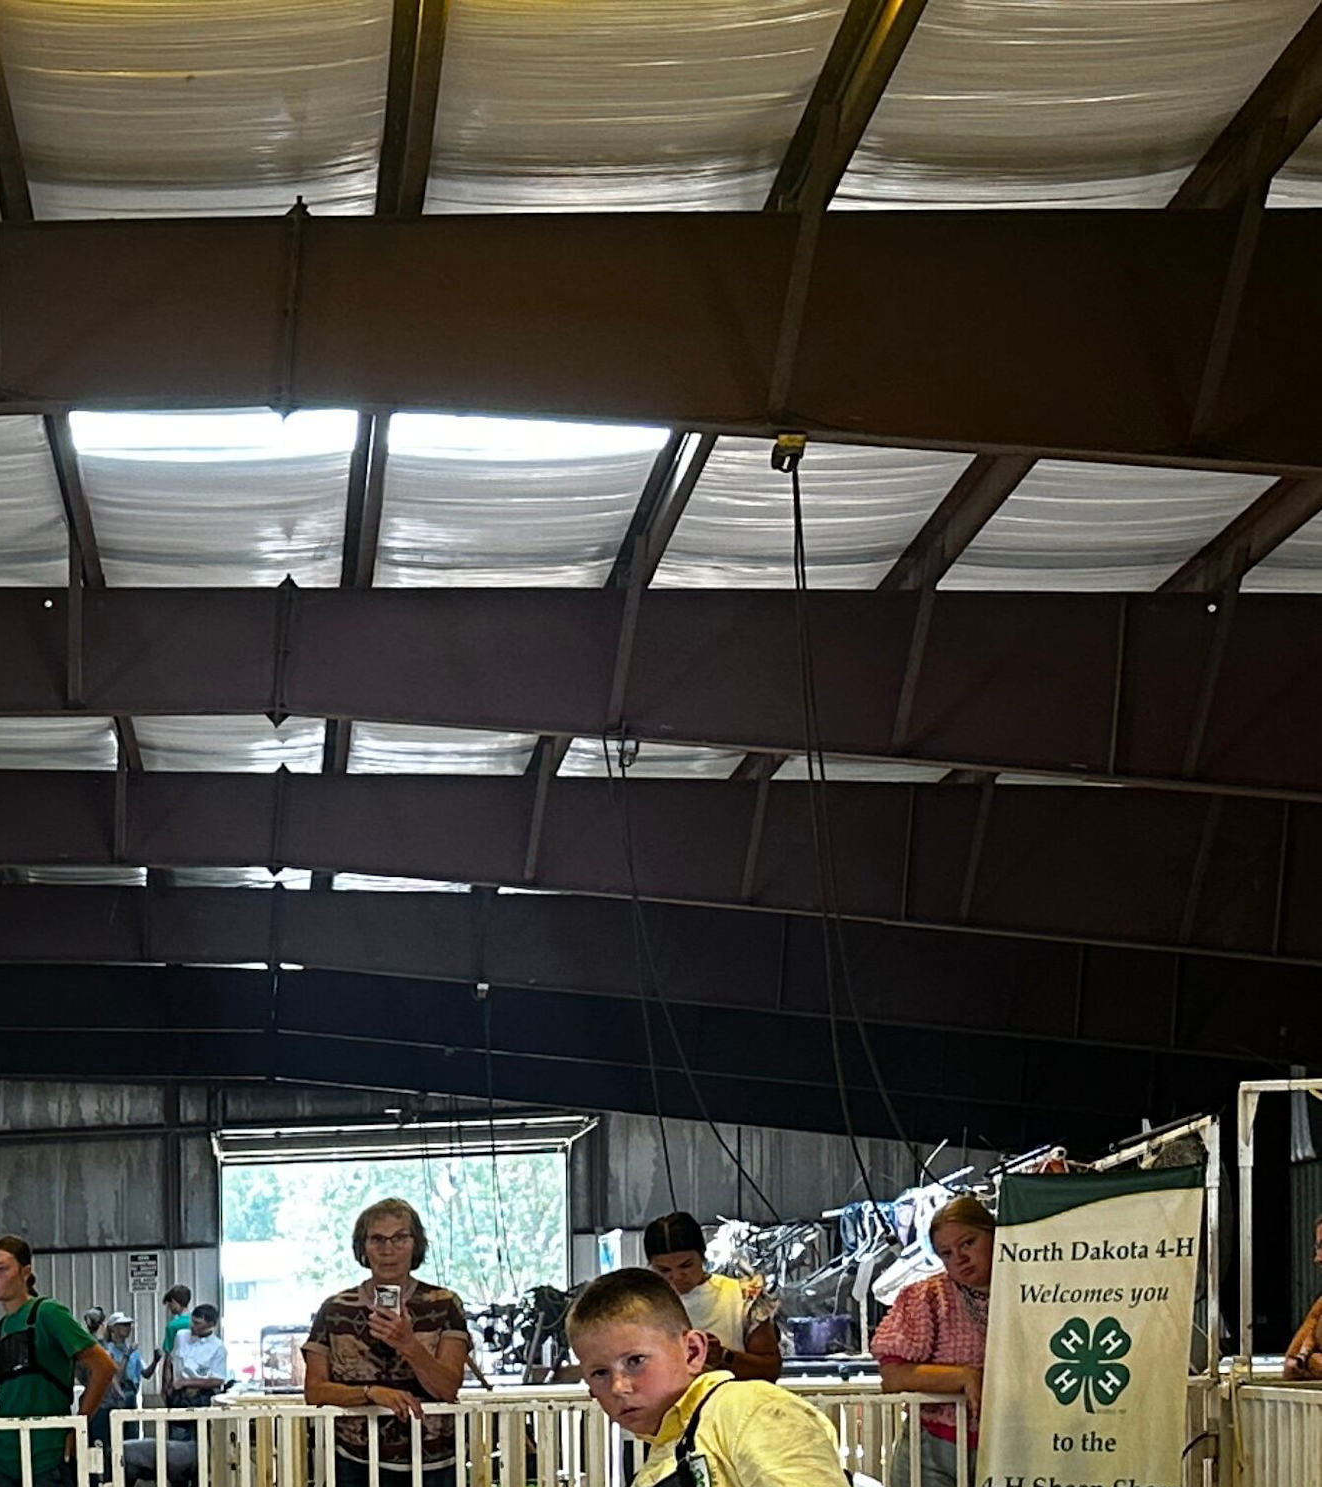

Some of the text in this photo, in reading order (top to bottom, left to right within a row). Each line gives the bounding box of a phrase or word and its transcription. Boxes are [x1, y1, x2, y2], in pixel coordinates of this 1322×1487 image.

[998, 1237, 1195, 1262] North Dakota 4-H
[1020, 1282, 1169, 1308] Welcomes you
[1053, 1431, 1117, 1452] to the
